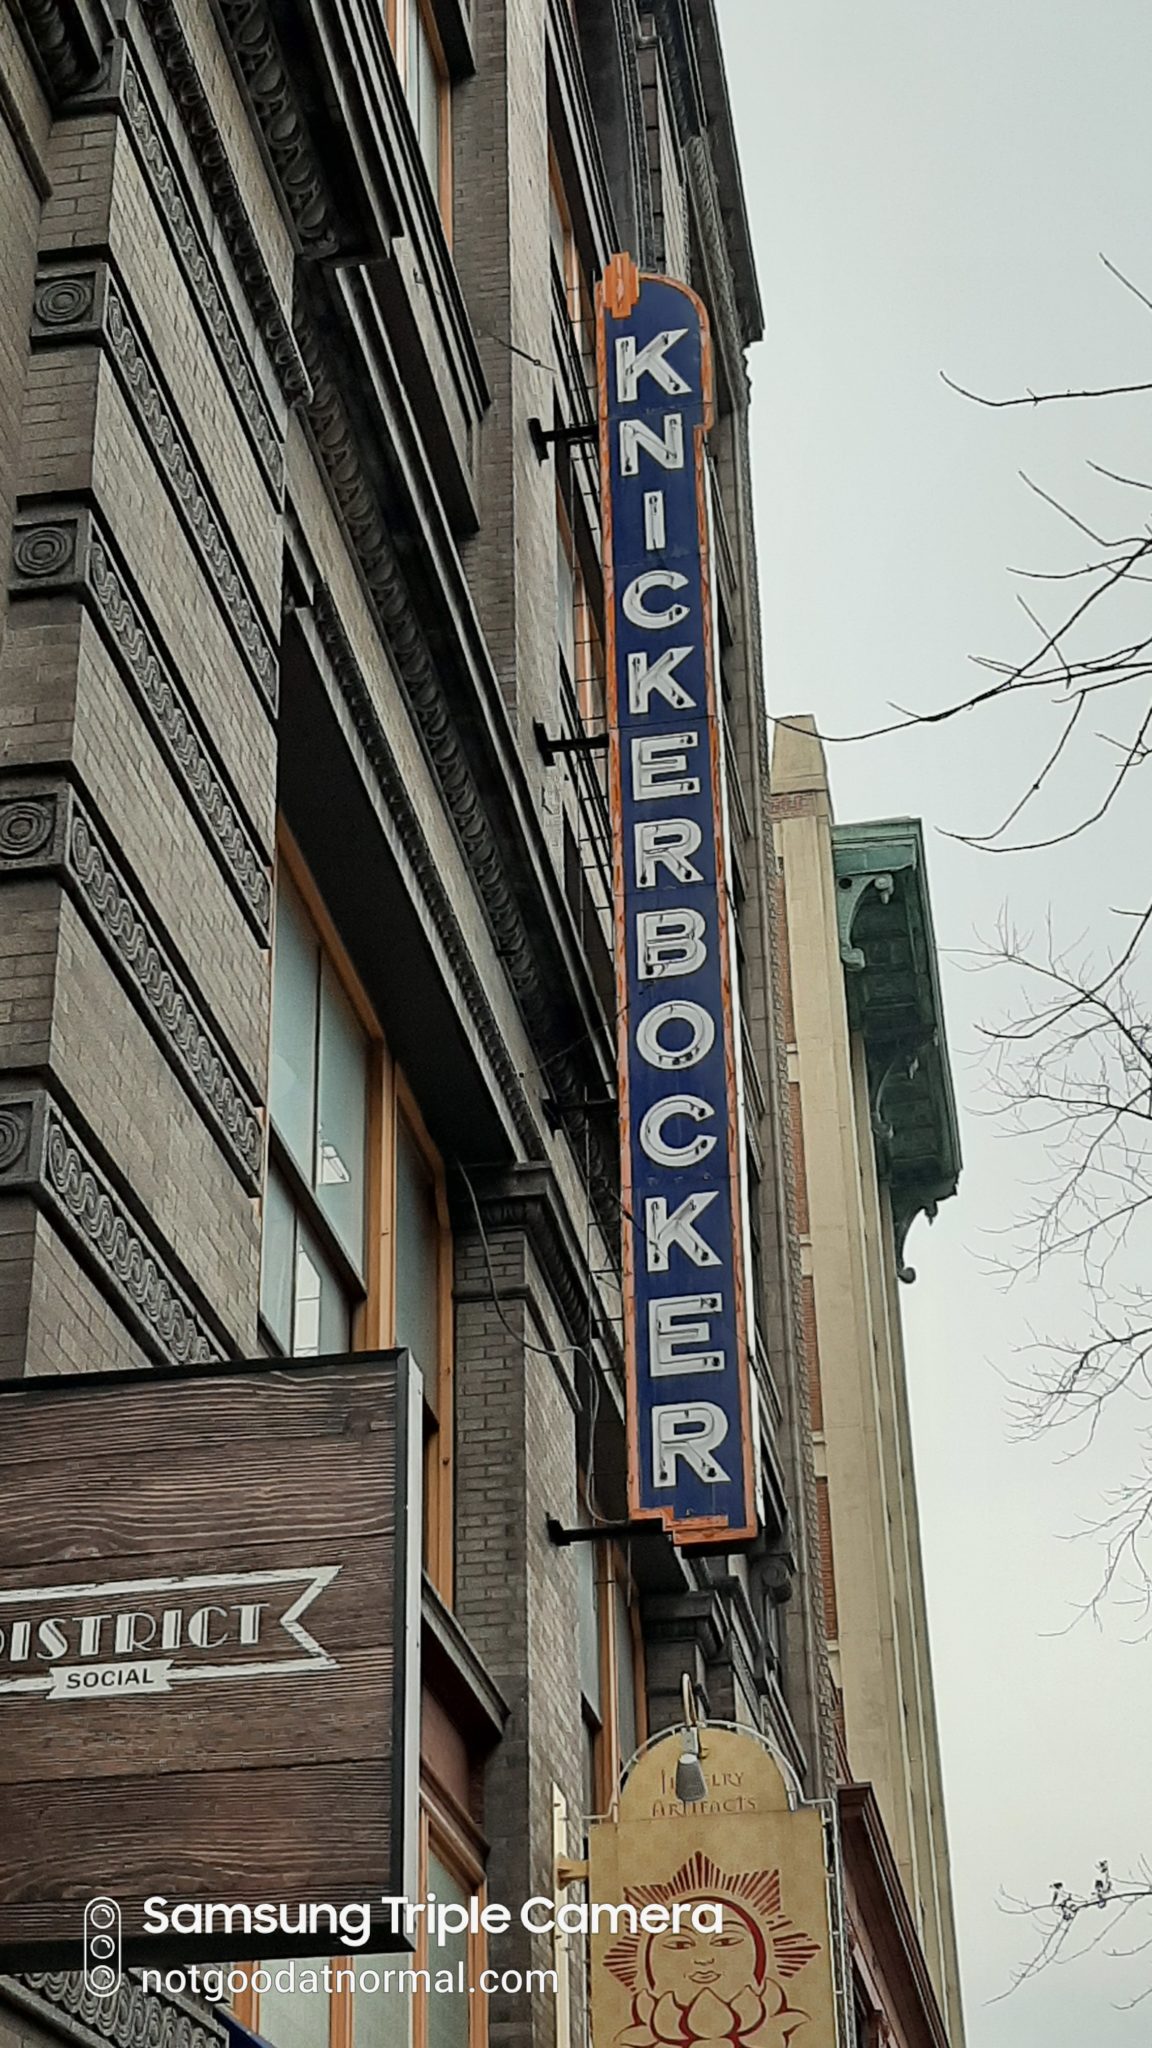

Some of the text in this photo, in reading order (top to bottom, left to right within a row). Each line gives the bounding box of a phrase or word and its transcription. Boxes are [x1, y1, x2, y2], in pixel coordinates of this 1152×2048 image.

[614, 328, 731, 1488] KNICKERBOCKER
[0, 1603, 270, 1662] ISTRICT
[66, 1668, 155, 1689] SOCIAL
